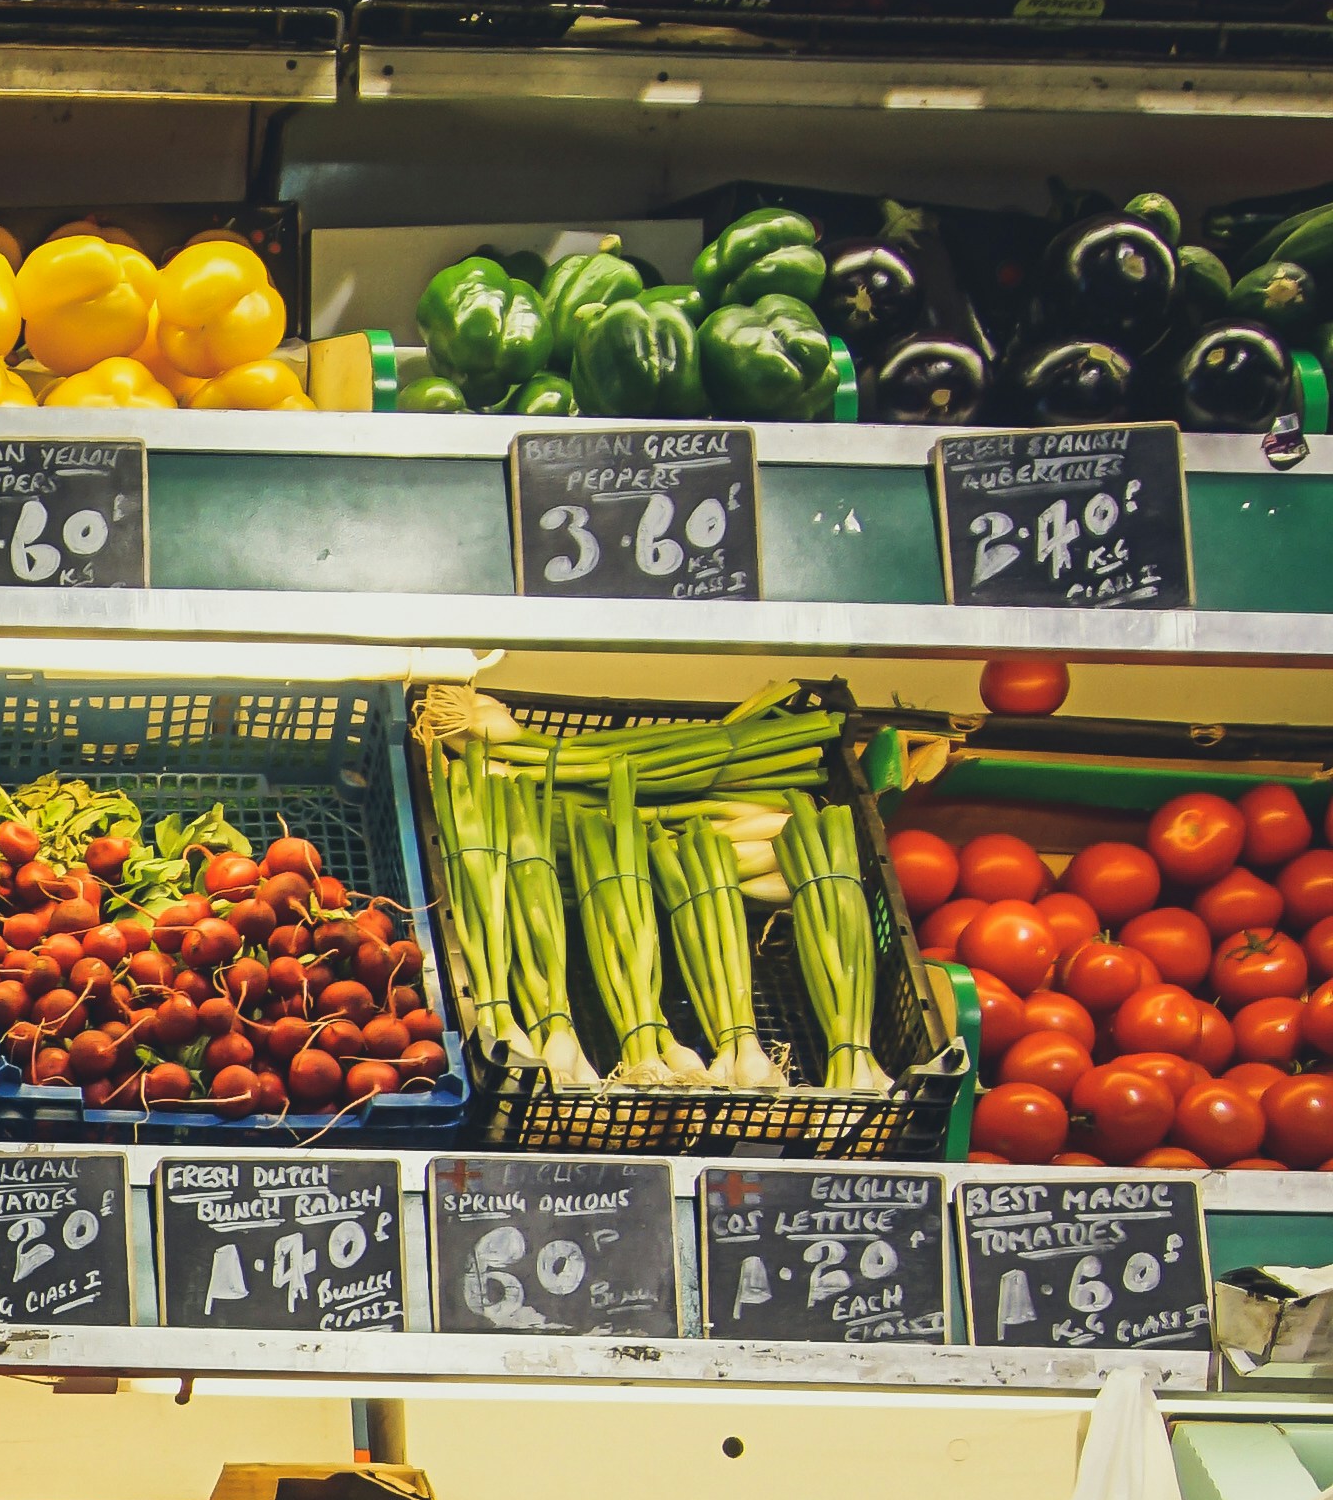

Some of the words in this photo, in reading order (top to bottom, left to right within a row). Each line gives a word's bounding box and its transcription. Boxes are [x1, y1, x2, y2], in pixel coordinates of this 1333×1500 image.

[644, 432, 729, 459] GREEN
[1028, 430, 1132, 455] SPANISH
[41, 447, 119, 469] YELLOW
[567, 468, 682, 491] PEPPERS
[962, 460, 1124, 490] AUBERGINES
[167, 1164, 239, 1189] FRESH
[253, 1164, 329, 1187] DUTCH
[811, 1176, 929, 1201] ENGLISH
[197, 1197, 280, 1222] BUNCH
[295, 1184, 382, 1217] RADISH
[444, 1191, 526, 1213] SPRING
[539, 1187, 630, 1213] ONIONS
[966, 1185, 1048, 1216] BEST
[1063, 1183, 1173, 1210] MAROC
[712, 1210, 763, 1235] COS
[775, 1209, 898, 1235] LETTUCE
[971, 1220, 1127, 1256] TOMATOES
[317, 1270, 392, 1308] BUNCH
[833, 1285, 903, 1321] EACH
